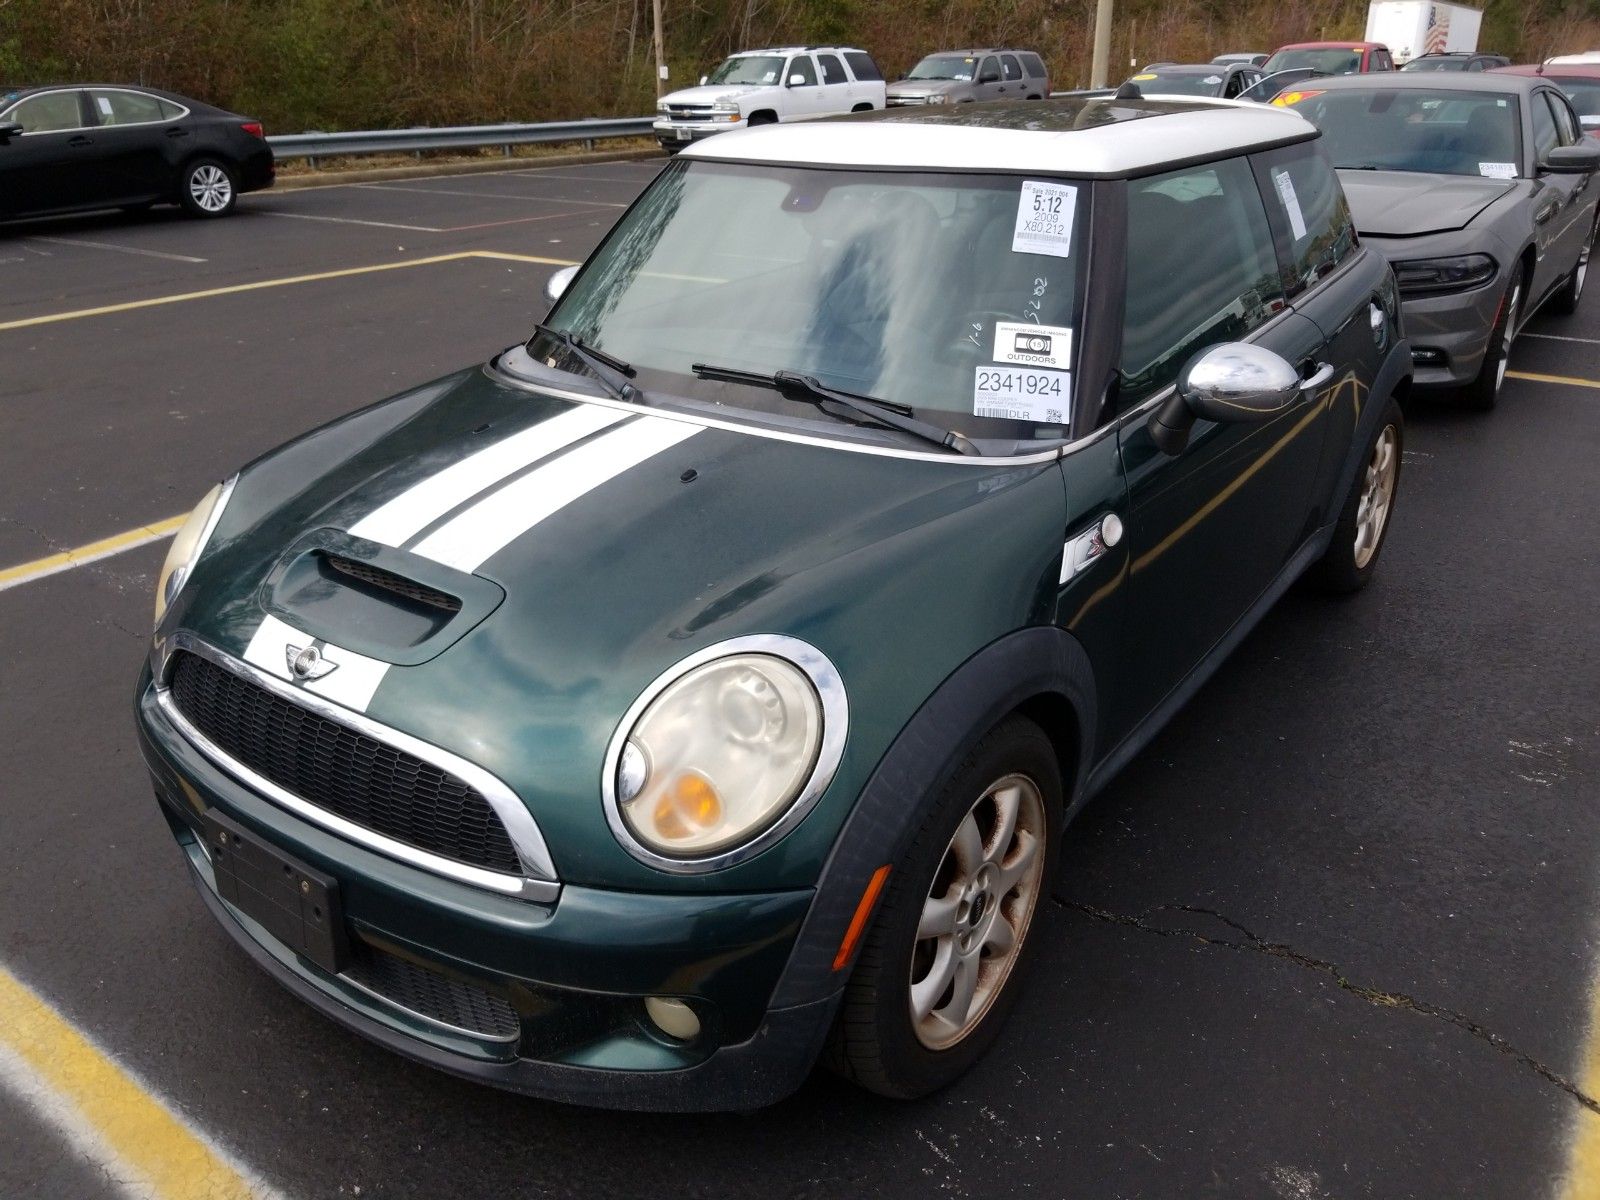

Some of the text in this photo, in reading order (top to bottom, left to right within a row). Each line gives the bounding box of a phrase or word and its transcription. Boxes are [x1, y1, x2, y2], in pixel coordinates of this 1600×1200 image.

[1032, 187, 1044, 195] Sale
[1033, 194, 1062, 213] 5:12
[1034, 211, 1059, 222] 2009
[1007, 353, 1056, 365] OUTDOORS
[978, 372, 1061, 396] 2341924
[1009, 409, 1030, 420] DLR
